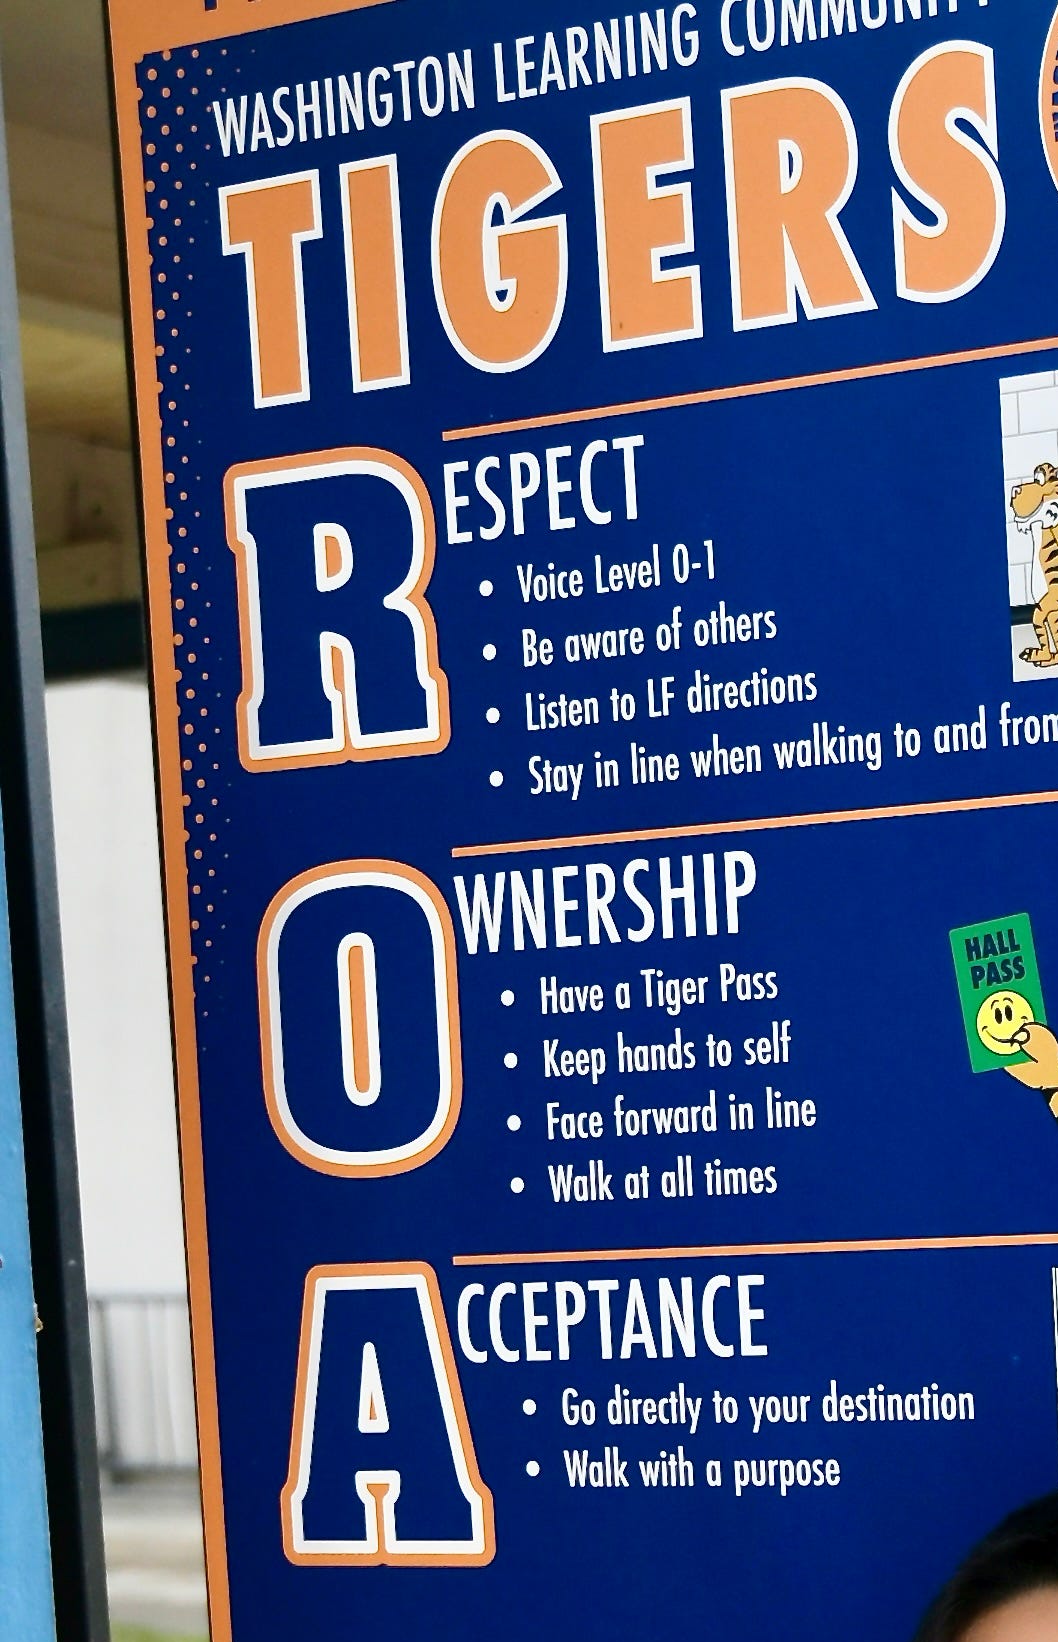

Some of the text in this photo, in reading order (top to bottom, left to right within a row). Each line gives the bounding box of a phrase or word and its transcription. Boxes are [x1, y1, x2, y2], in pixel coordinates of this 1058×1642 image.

[212, 0, 990, 158] WASHINGTON LEARNING COMMU
[219, 40, 1005, 410] TIGERS
[516, 539, 715, 603] Voice Level 0-1
[521, 600, 777, 668] Be aware of others
[525, 667, 818, 731] Listen to LF directions
[528, 755, 584, 801] Stay
[594, 751, 620, 788] in
[630, 742, 680, 785] line
[689, 733, 762, 778] when
[772, 721, 882, 771] walking
[893, 722, 921, 758] to
[933, 704, 987, 754] and
[964, 928, 1020, 962] HALL
[970, 955, 1025, 989] PASS
[540, 963, 778, 1016] Have a Tiger Pass
[543, 1019, 792, 1085] Keep hands to self
[546, 1086, 817, 1141] Face forward in line
[547, 1155, 778, 1203] Walk at all times
[561, 1379, 975, 1435] Go directly to your destination
[563, 1445, 841, 1497] Walk with a purpose
